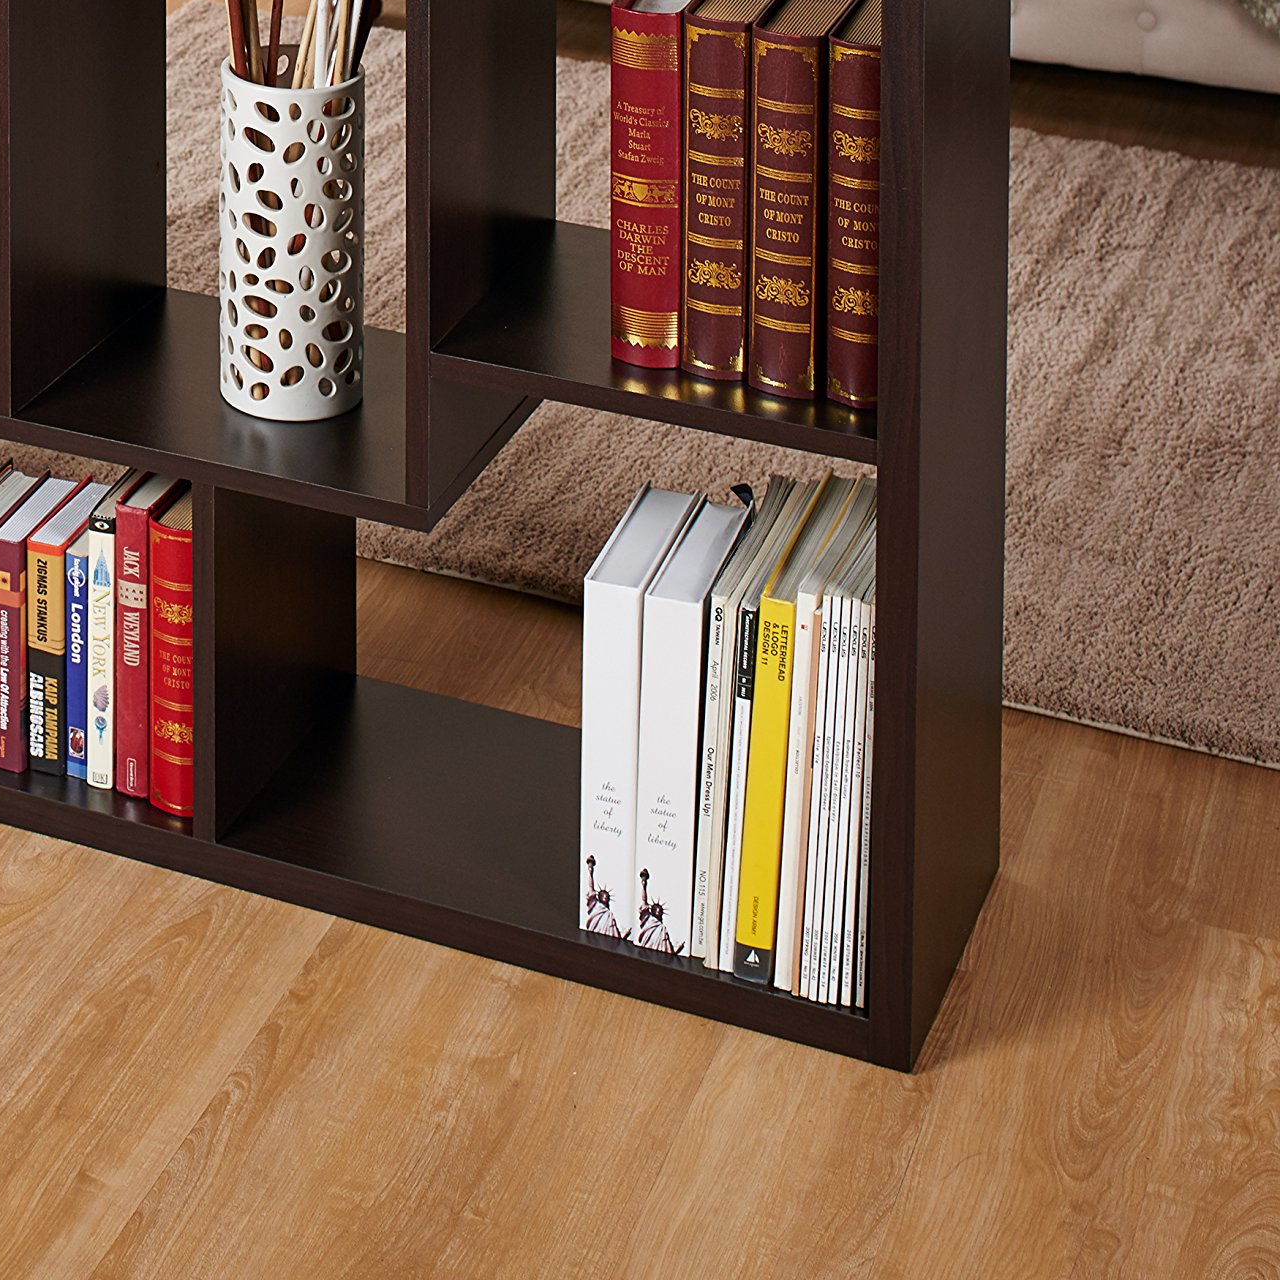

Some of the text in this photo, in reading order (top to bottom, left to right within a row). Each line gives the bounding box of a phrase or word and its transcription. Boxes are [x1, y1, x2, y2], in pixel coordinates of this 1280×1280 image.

[616, 101, 622, 110] A
[623, 102, 656, 117] Treasury
[638, 117, 669, 128] Classics
[628, 139, 651, 151] Stuart
[640, 154, 664, 166] Zweig
[691, 173, 742, 190] THE COUNT
[695, 193, 735, 209] OF MONT
[759, 187, 809, 207] THE COUNT
[834, 197, 852, 211] THE
[698, 212, 732, 227] CRISTO
[763, 208, 803, 225] OF MONT
[837, 216, 850, 228] OF
[616, 218, 669, 235] CHARLES
[619, 229, 666, 245] DARWIN
[766, 227, 800, 244] CRISTO
[841, 235, 878, 251] CRISTO
[630, 242, 654, 255] THE
[617, 249, 670, 266] DESCENT
[619, 260, 666, 276] OF MAN
[123, 546, 140, 579] JACK
[36, 558, 48, 642] ZIGMAS STANKUS
[715, 606, 723, 622] GQ
[70, 603, 84, 664] London
[123, 612, 140, 667] WEYLAND
[770, 622, 779, 656] & LOGO
[0, 639, 10, 654] with
[761, 620, 771, 665] DESIGN 11
[0, 655, 9, 667] the
[777, 624, 790, 682] LETTERHEAD
[0, 667, 10, 683] Law
[162, 663, 191, 677] OF MONT
[0, 683, 10, 694] Of
[163, 676, 190, 690] CRISTO
[709, 660, 720, 702] April 2006
[0, 694, 10, 730] Attraction
[45, 676, 58, 760] KAIP TAMPAMA
[601, 781, 616, 792] the
[703, 747, 715, 817] Our Men Dress Up!
[595, 794, 622, 806] statue
[656, 794, 671, 806] the
[603, 807, 614, 819] of
[650, 807, 678, 819] statue
[593, 819, 623, 838] liberty
[657, 819, 668, 832] of
[647, 833, 678, 851] liberty
[750, 896, 760, 936] DESIGN ARMY
